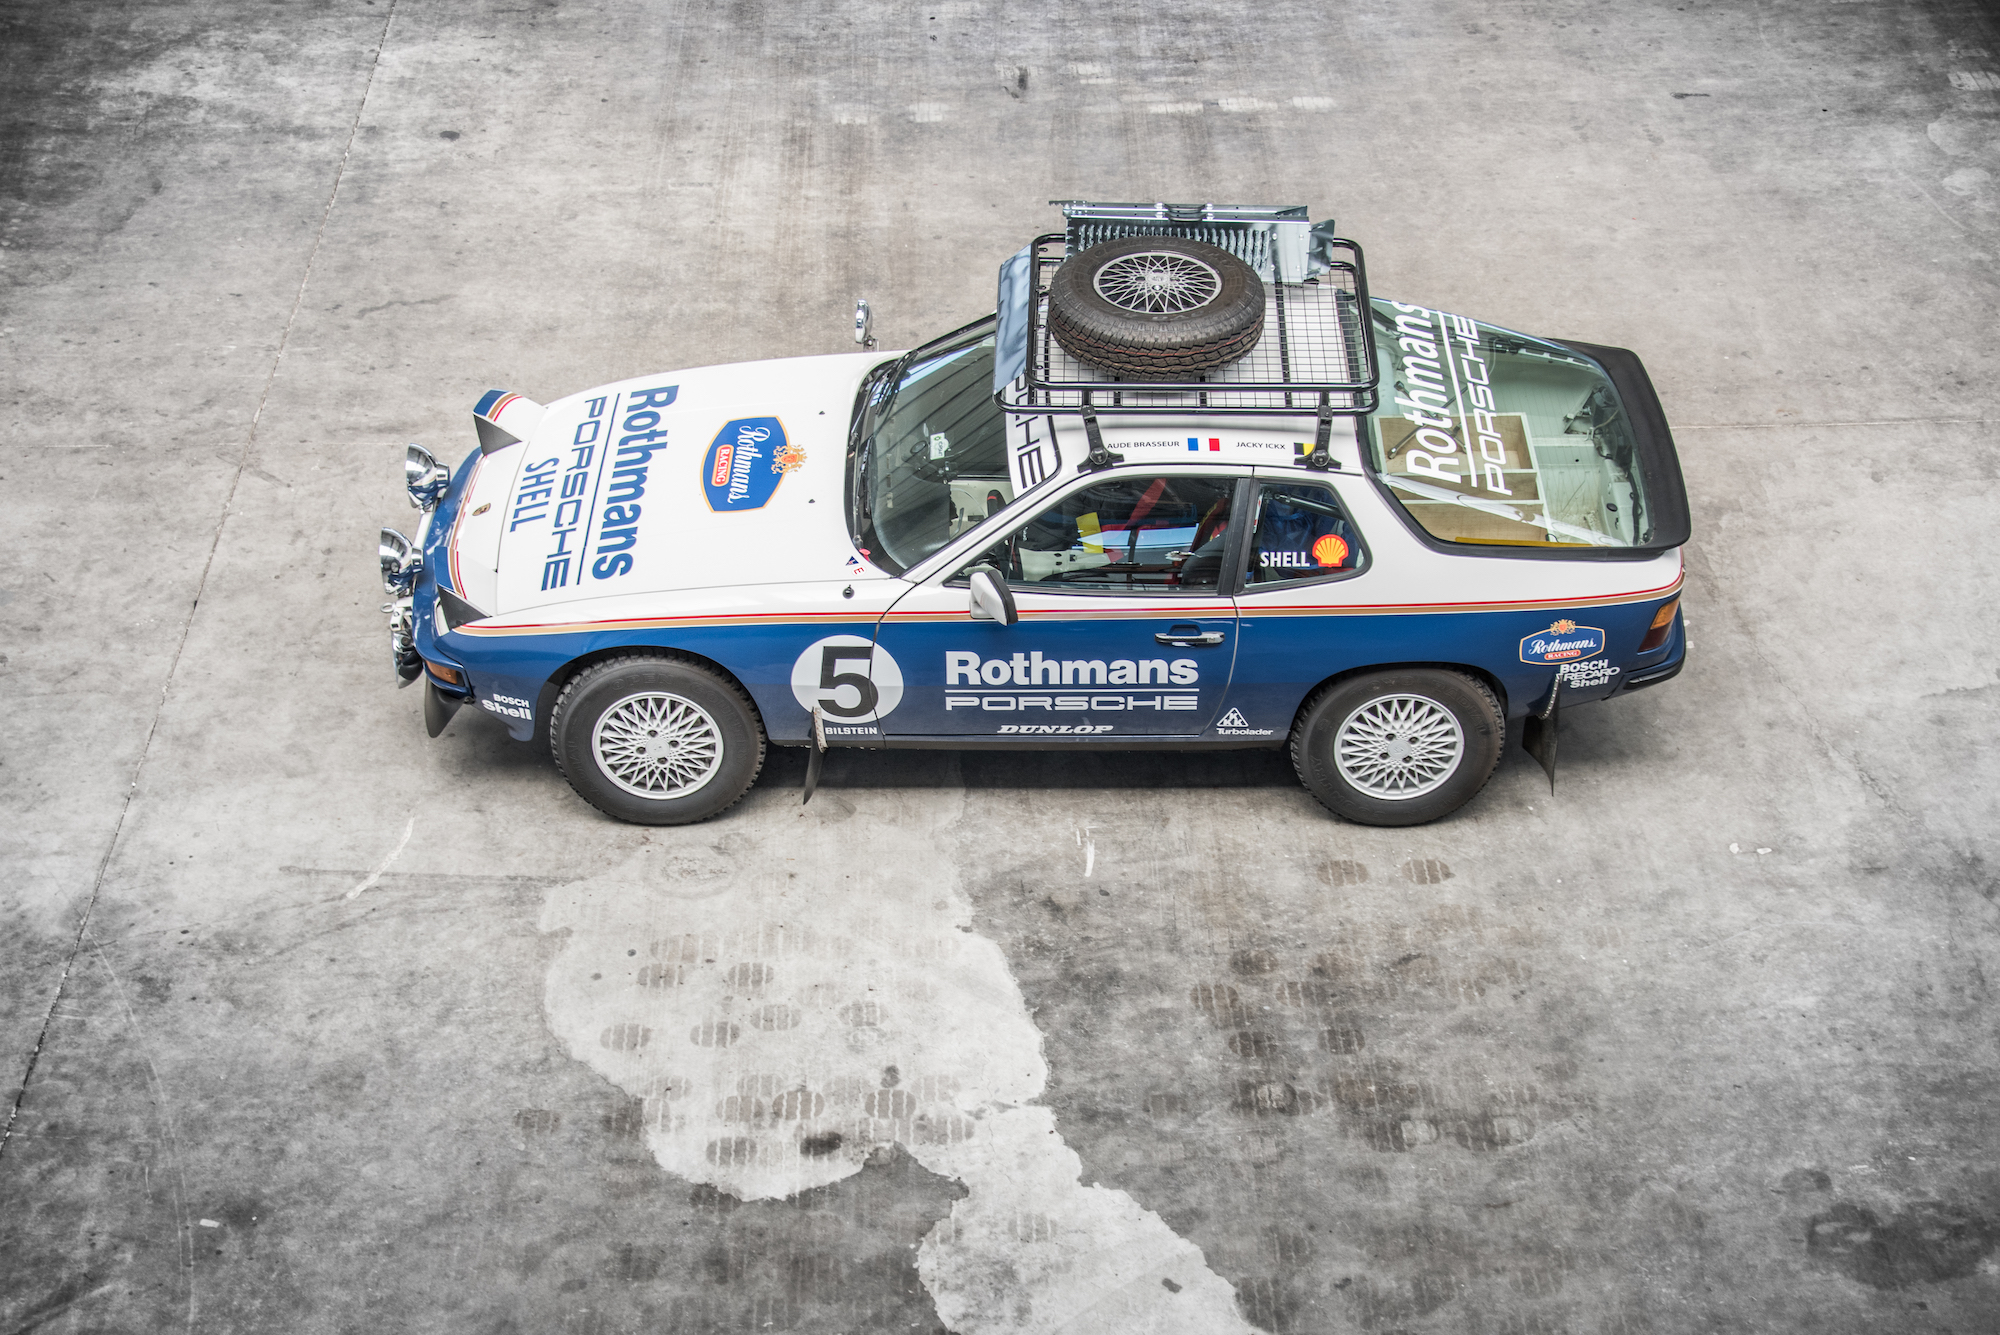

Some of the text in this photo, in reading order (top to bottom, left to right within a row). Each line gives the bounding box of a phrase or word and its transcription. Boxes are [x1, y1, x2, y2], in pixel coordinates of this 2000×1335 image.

[1391, 300, 1462, 484] Rothmans
[1451, 314, 1513, 496] PORSCHE
[1235, 441, 1263, 449] JACKY
[715, 448, 731, 483] RACING
[727, 425, 771, 504] Rothmans
[591, 385, 680, 580] Rothmans
[509, 457, 560, 533] SHELL
[541, 396, 608, 592] PORSCHE
[1259, 551, 1311, 568] SHELL
[1528, 637, 1597, 655] Rothmans
[1547, 650, 1579, 659] RACING
[945, 651, 1199, 686] Rothmans
[1560, 659, 1609, 675] BOSCH
[1562, 667, 1621, 682] RECARO
[611, 673, 673, 691] OPEN
[817, 645, 879, 718] 5
[1569, 676, 1609, 689] Shell
[492, 693, 530, 708] BOSCH
[945, 696, 1198, 711] PORSCHE
[481, 699, 532, 721] Shell
[825, 726, 878, 735] BILSTEIN
[997, 725, 1114, 734] DUNLOP
[1216, 727, 1274, 736] Turbolader
